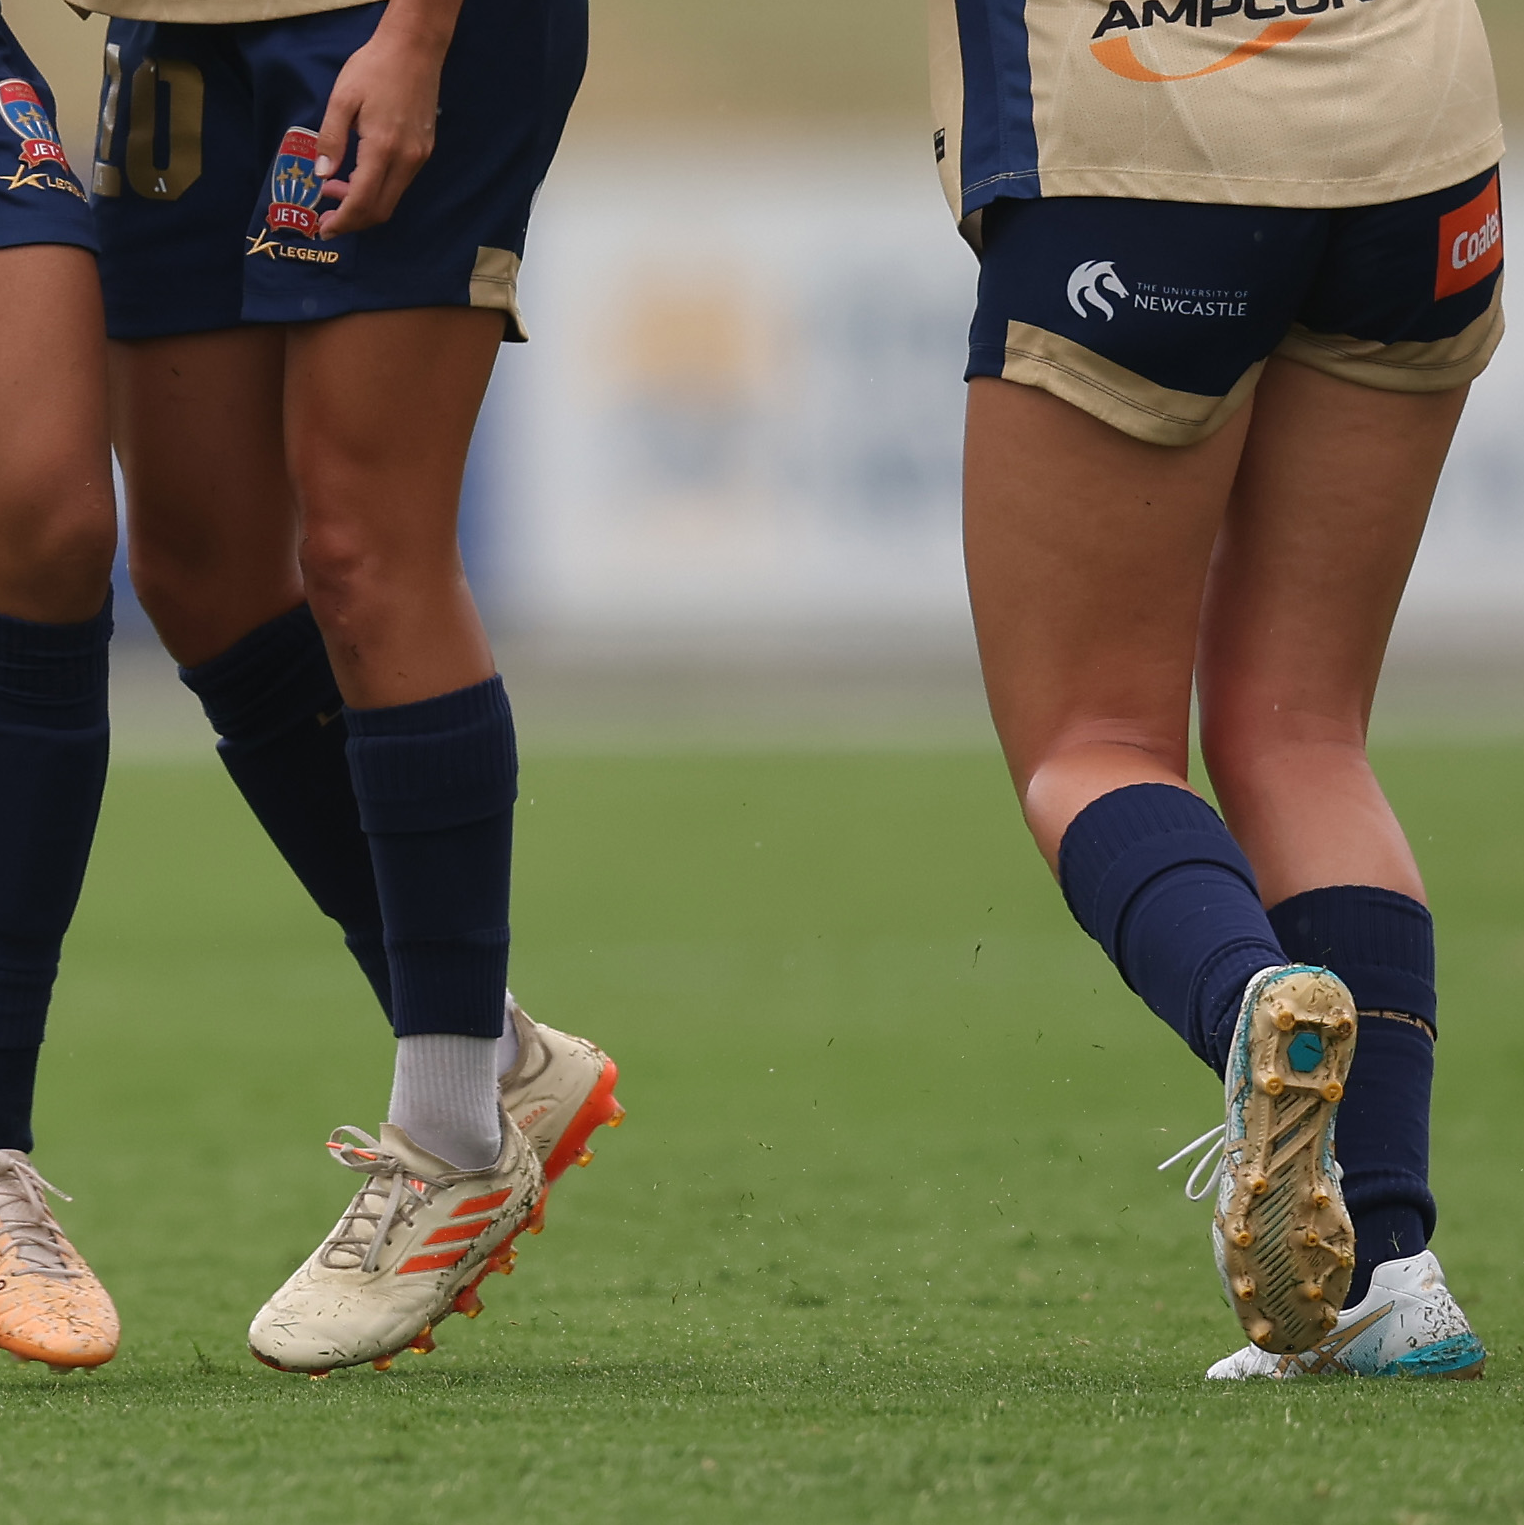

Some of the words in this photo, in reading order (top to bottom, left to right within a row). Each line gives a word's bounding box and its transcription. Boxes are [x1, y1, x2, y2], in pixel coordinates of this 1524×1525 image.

[92, 42, 205, 202] 10
[274, 207, 310, 228] JETS
[279, 244, 340, 264] LEGEND
[1137, 281, 1158, 293] THE
[1163, 285, 1230, 298] UNIVERSITY
[1234, 290, 1248, 299] OF
[1134, 293, 1248, 316] NEWCASTLE
